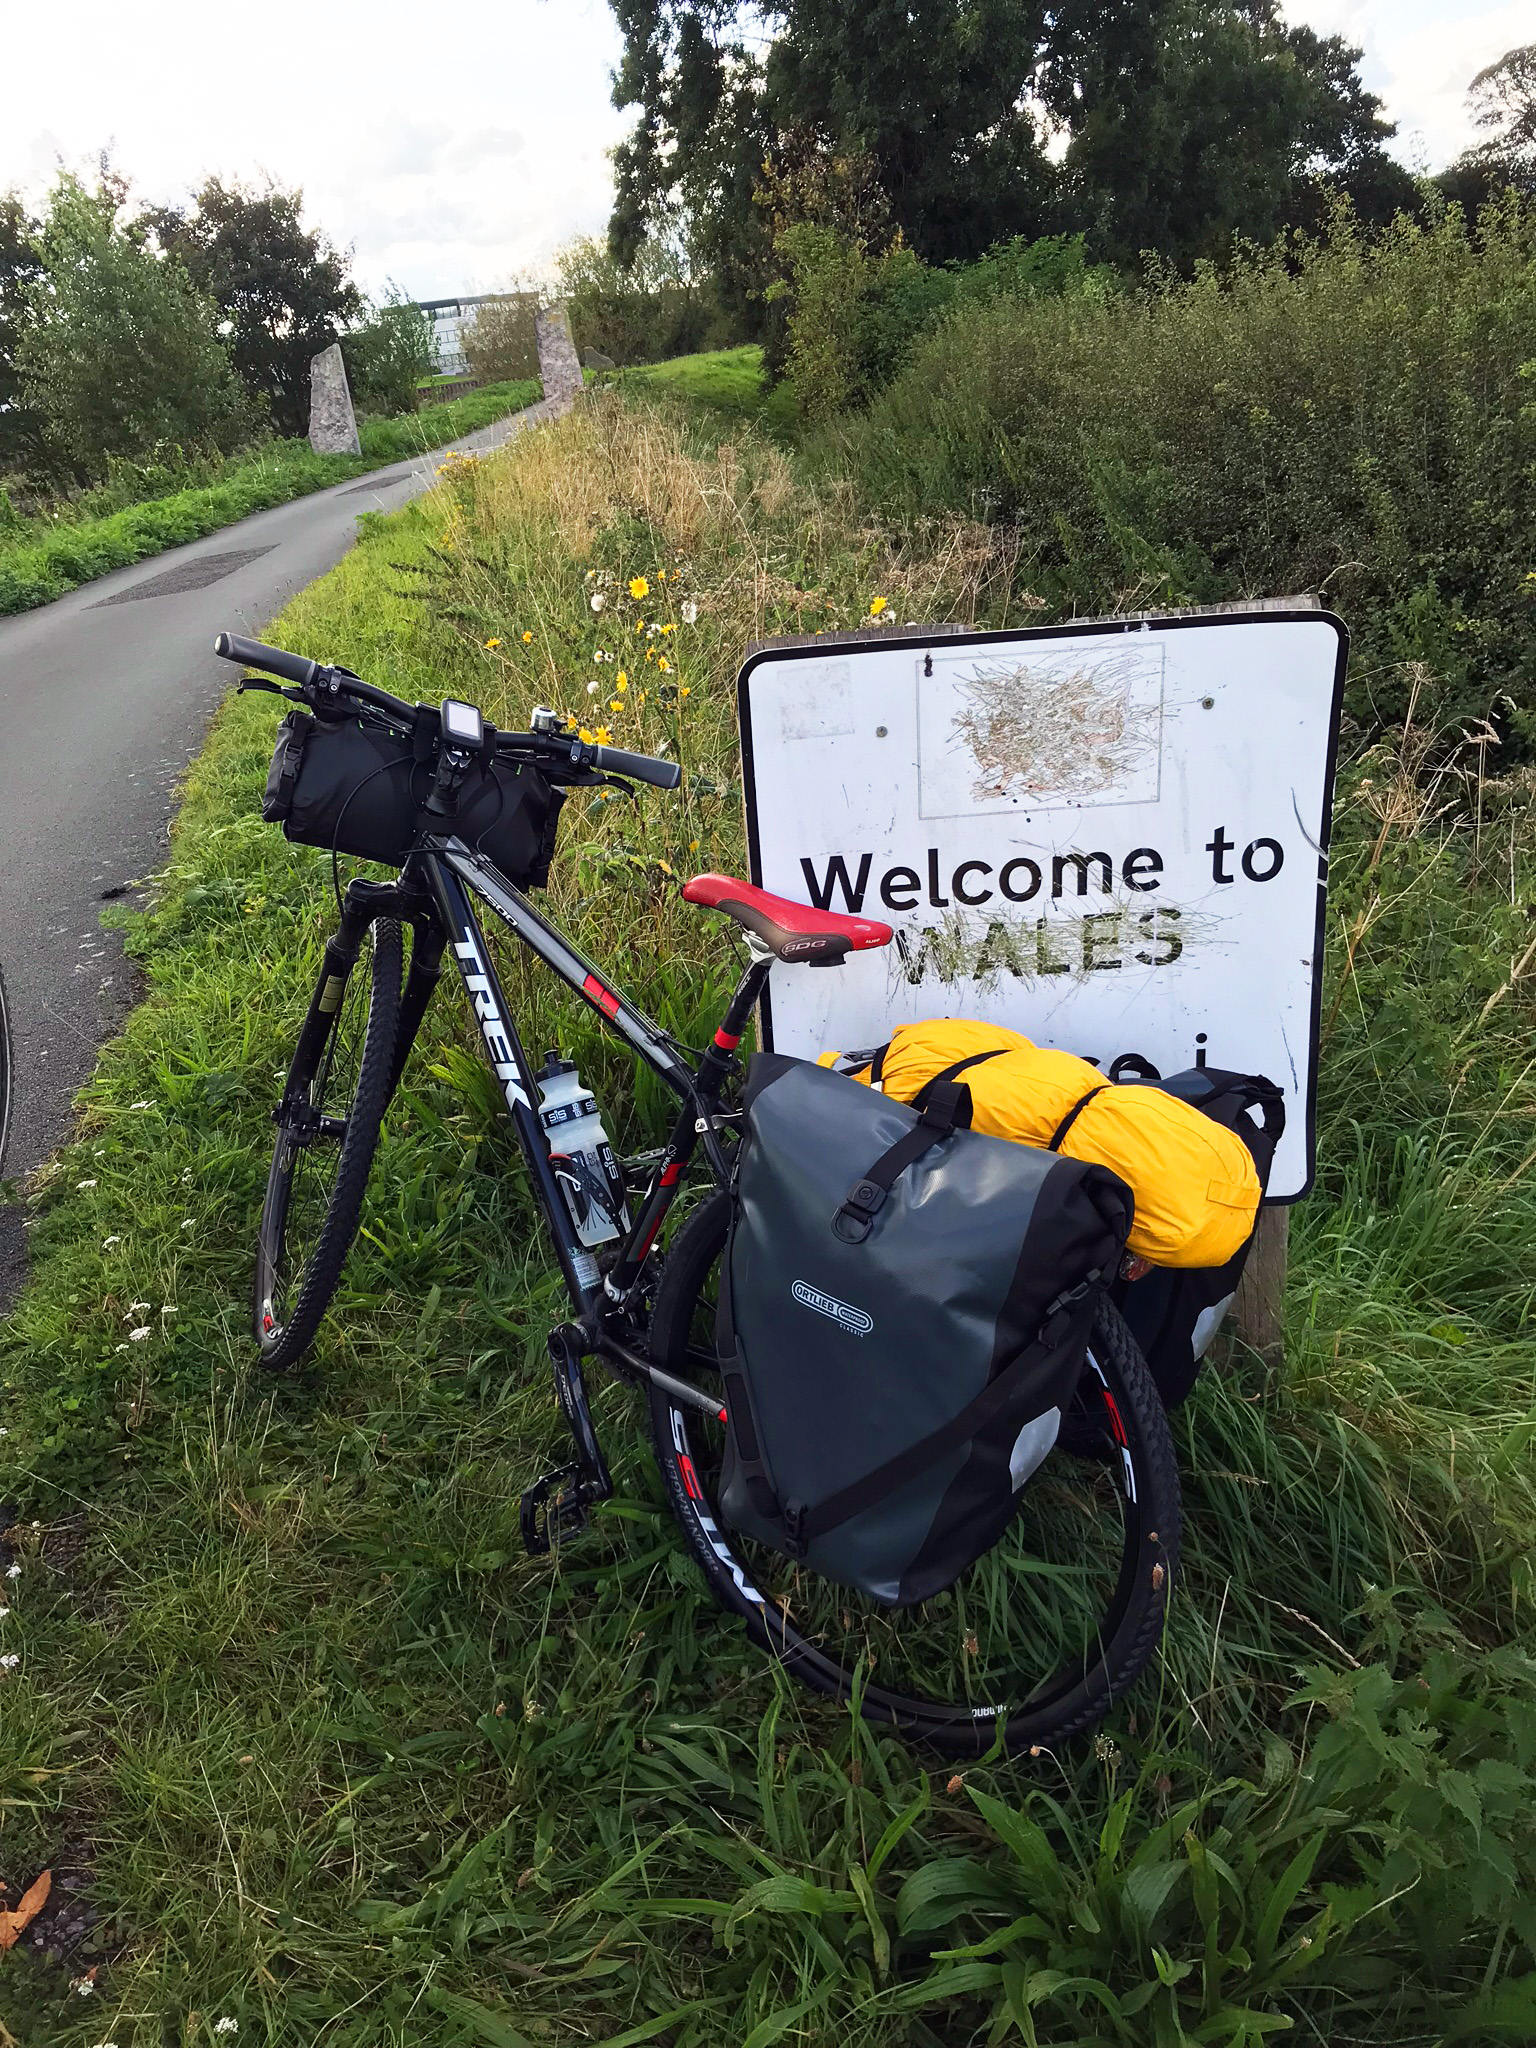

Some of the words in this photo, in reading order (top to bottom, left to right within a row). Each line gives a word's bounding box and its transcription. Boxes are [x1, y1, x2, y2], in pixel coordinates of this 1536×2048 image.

[799, 846, 1164, 914] Welcome
[1205, 825, 1285, 884] to
[476, 884, 518, 926] 7500
[783, 939, 827, 954] SDG
[895, 908, 1183, 985] WALES
[454, 926, 532, 1112] TREK
[796, 1286, 835, 1312] ORTLIEB
[839, 1323, 864, 1338] CLASSIC
[664, 1458, 715, 1566] BONTRAGER
[972, 1704, 1013, 1718] HIMANO
